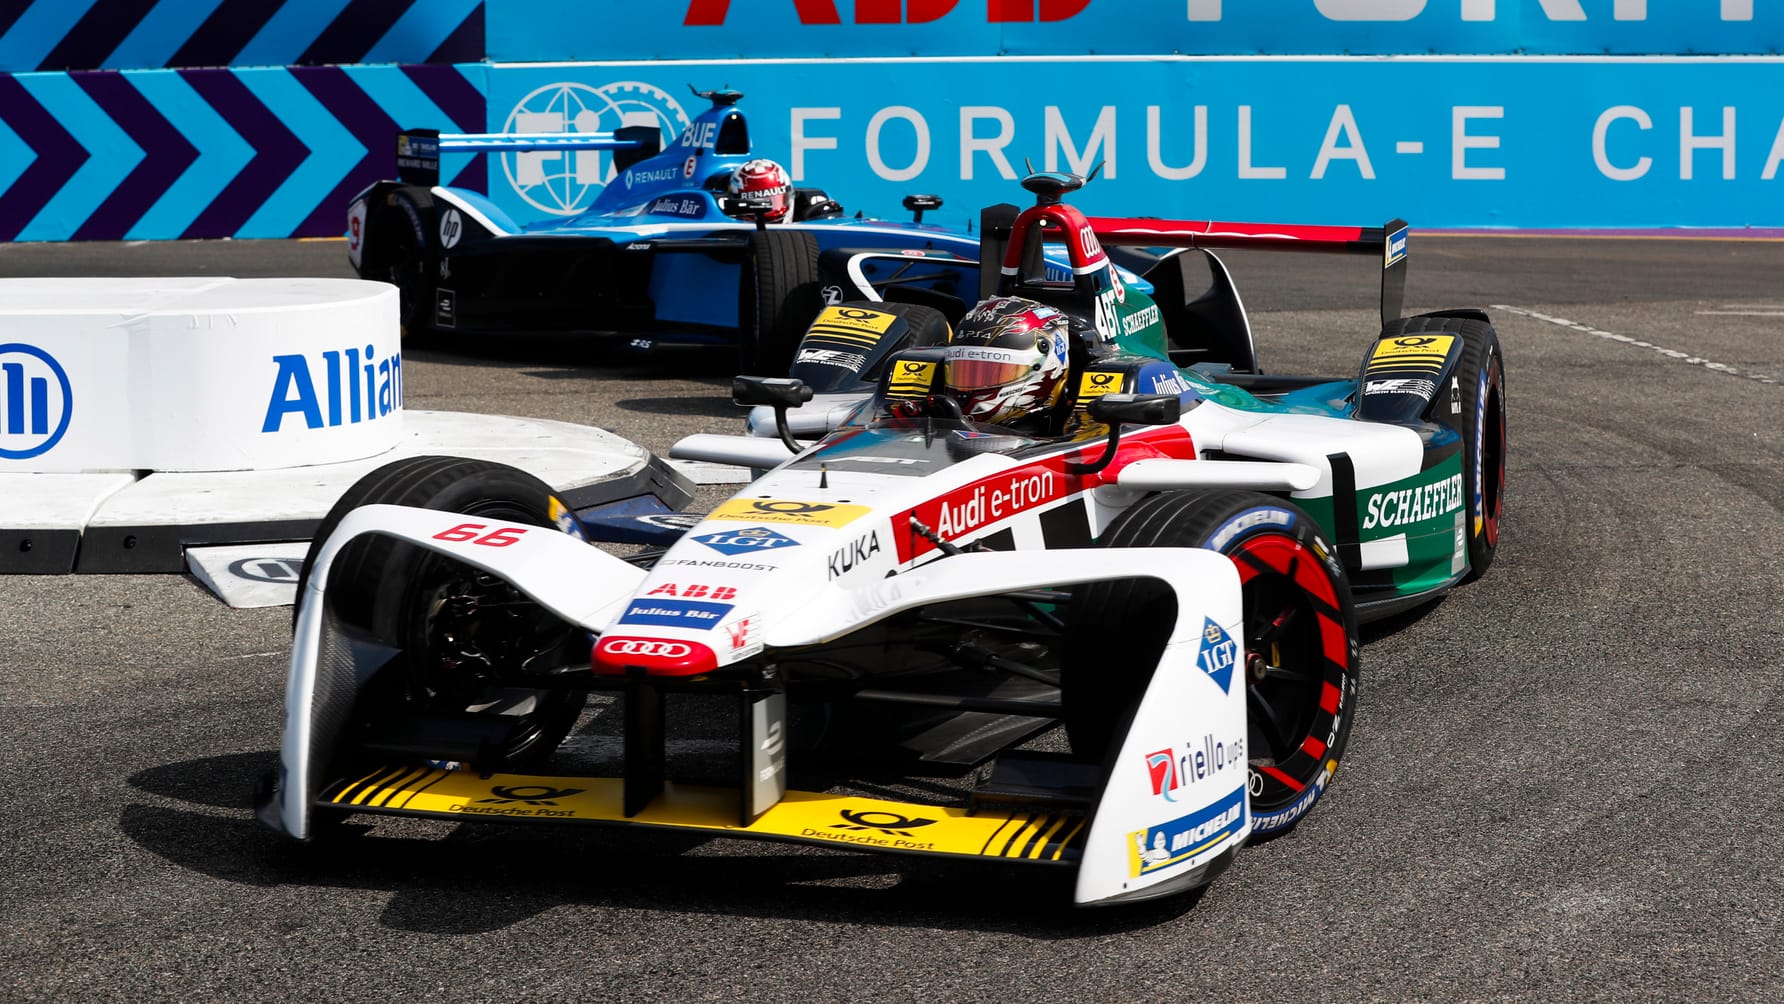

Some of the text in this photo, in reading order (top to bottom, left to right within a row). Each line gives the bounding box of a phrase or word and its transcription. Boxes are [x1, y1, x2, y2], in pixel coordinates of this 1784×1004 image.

[681, 122, 716, 149] BUE
[790, 104, 1506, 182] FORMULA-E
[635, 168, 678, 184] RENAULT
[741, 186, 786, 200] RENAULT
[651, 198, 700, 216] Julius Bär
[351, 216, 361, 251] 9
[441, 209, 461, 249] hp
[1122, 303, 1160, 337] SCHAEFFLER
[966, 330, 992, 339] PS4
[968, 351, 1011, 361] e-tron
[937, 470, 1053, 538] Audi e-tron
[1362, 472, 1463, 529] SCHAEFFLER
[719, 513, 796, 523] Deutsche
[432, 523, 528, 547] 66
[704, 534, 788, 548] LGT
[676, 559, 779, 572] FANBOOST
[828, 529, 880, 582] KUKA
[646, 583, 737, 600] ABB
[628, 607, 721, 619] Julius Bär
[1200, 640, 1234, 674] LGT
[1180, 734, 1224, 787] riello
[448, 804, 576, 817] Deutsche Post
[1171, 801, 1242, 852] MICHELIN
[801, 828, 935, 850] Deutsche Post
